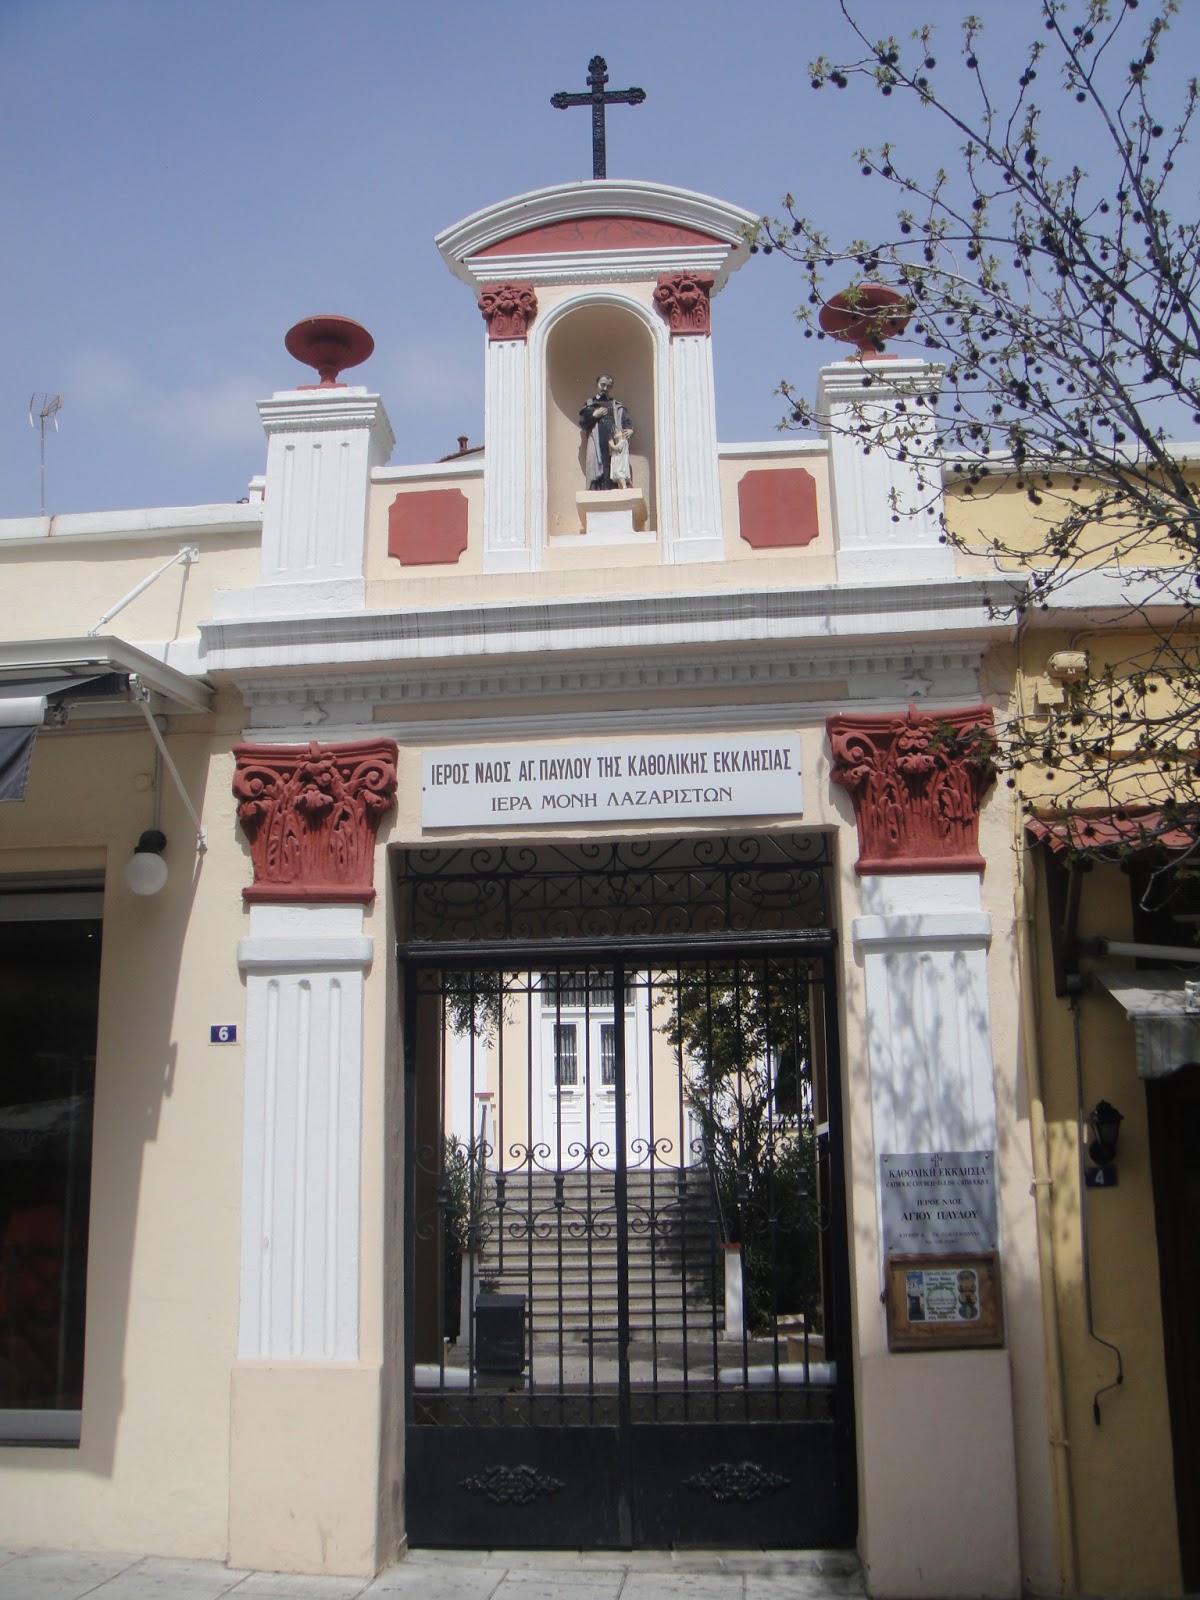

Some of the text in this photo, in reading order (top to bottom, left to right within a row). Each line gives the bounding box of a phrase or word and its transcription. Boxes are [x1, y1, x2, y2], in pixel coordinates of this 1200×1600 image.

[431, 763, 470, 786] ΙΕΡΟΣ
[475, 761, 511, 784] ΝΑΟΣ
[596, 756, 622, 778] ΤΗΣ
[628, 752, 709, 777] ΚΑΘΟΛΙΚΗΣ
[714, 749, 792, 773] ΕΚΚΛΗΣΙΑΣ
[491, 787, 733, 812] ΙΕΡΑ ΜΟΝΗ ΛΑΖΑΡΙΣΤΩΝ
[218, 1026, 229, 1041] 6
[888, 1167, 987, 1179] ΚΑΘΟΛΙΚΗ ΕΚΚΛΗΣΙΑ
[1094, 1169, 1105, 1185] 4
[900, 1210, 979, 1221] ΑΓΙΟΥ ΠΑΥΛΟΥ
